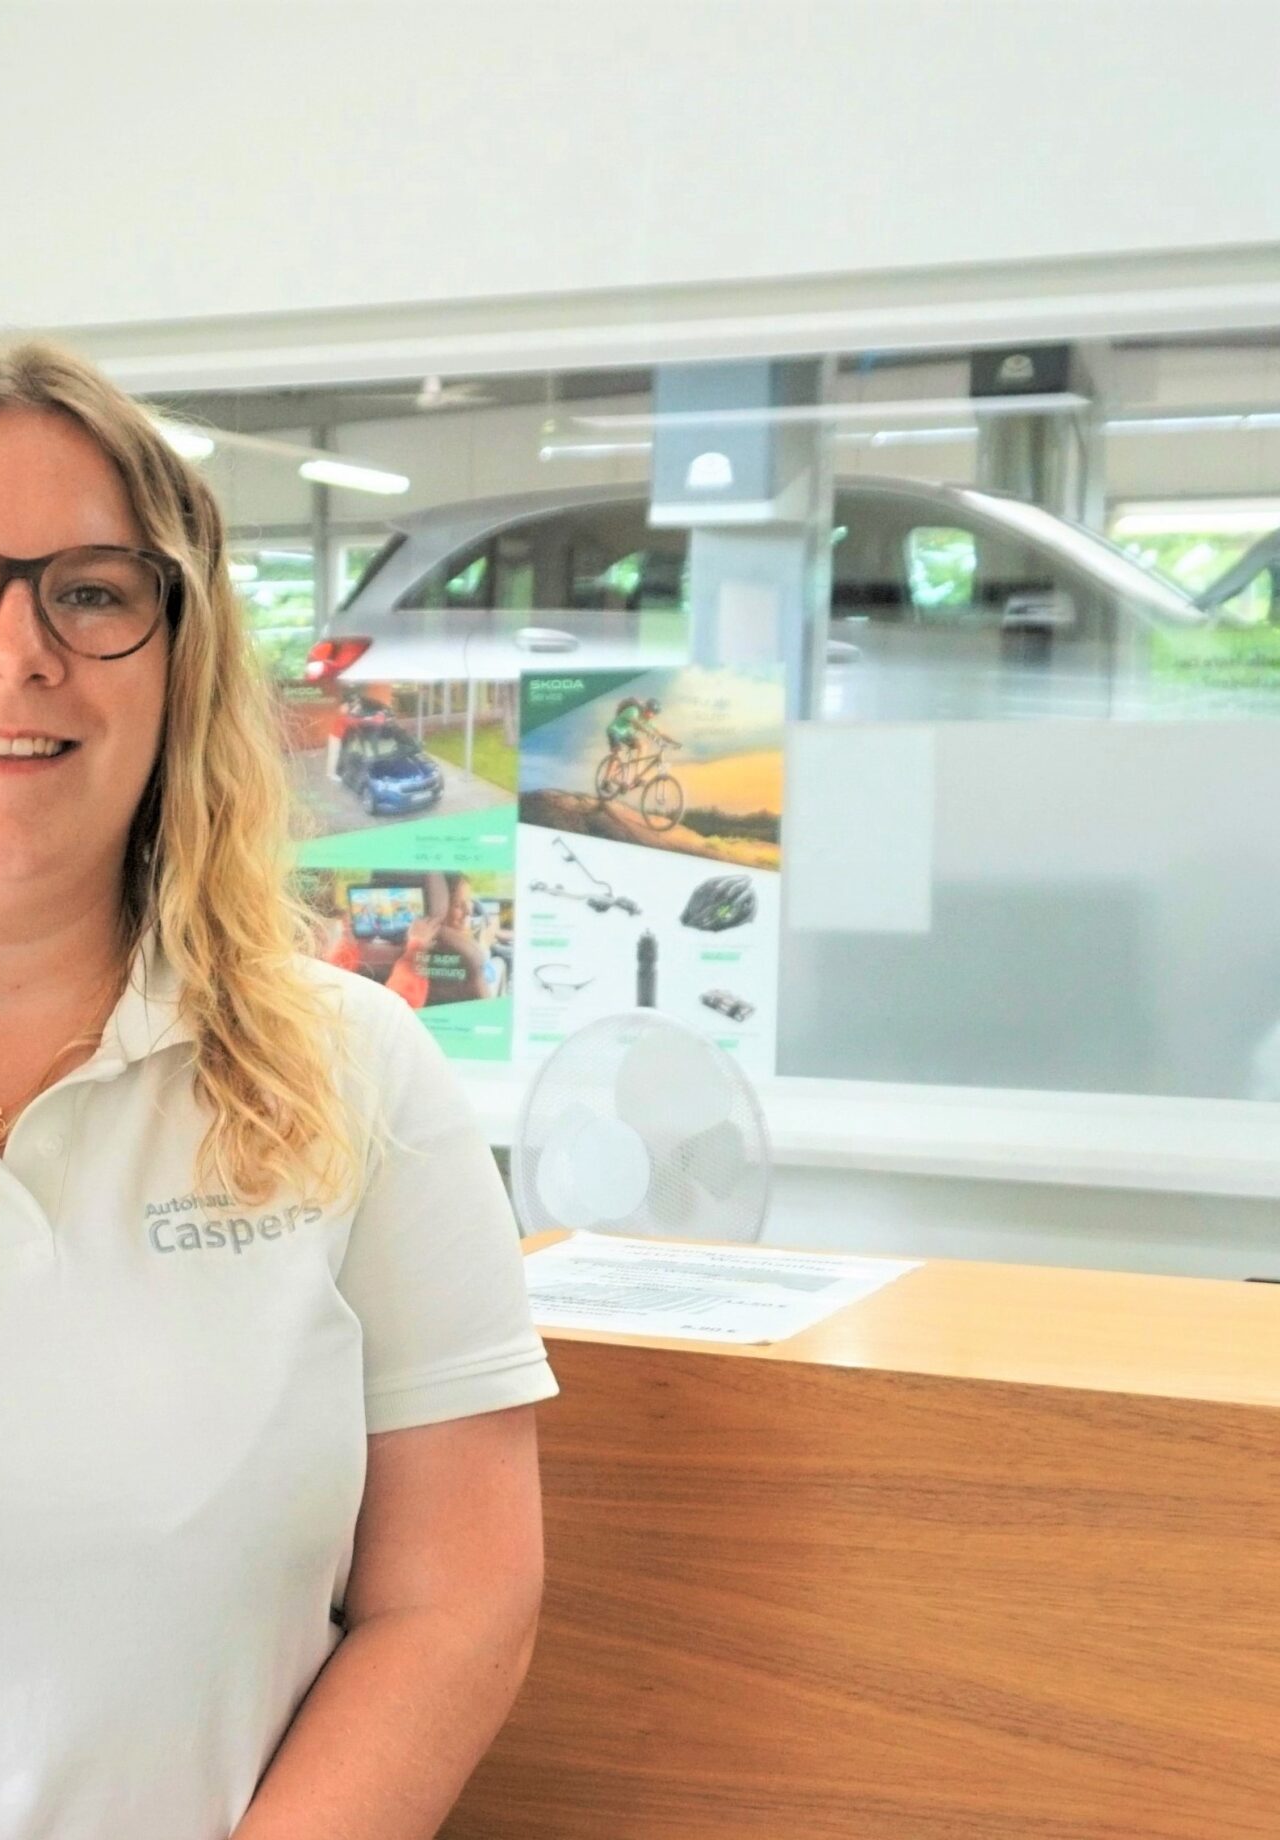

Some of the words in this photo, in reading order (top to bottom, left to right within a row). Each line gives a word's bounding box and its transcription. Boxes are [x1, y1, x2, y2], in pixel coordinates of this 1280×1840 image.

[433, 954, 461, 965] super
[144, 1193, 236, 1219] Autohau
[148, 1203, 323, 1255] Caspers
